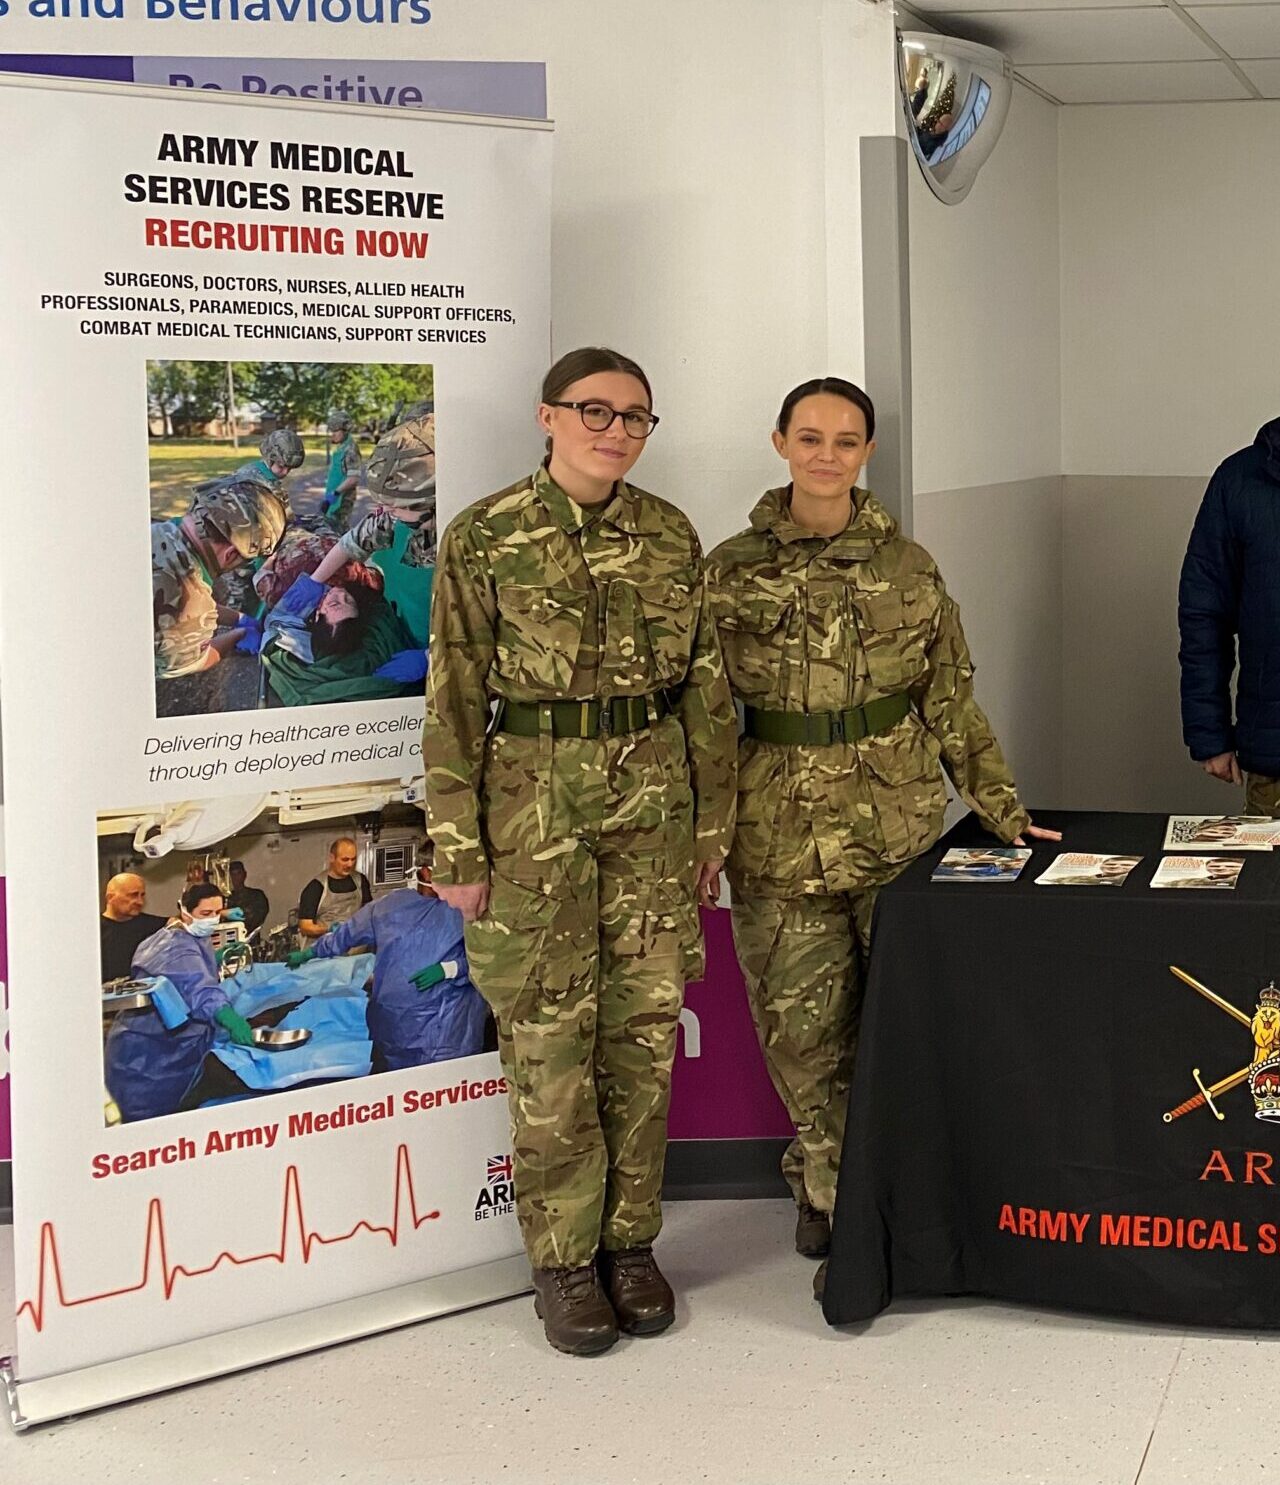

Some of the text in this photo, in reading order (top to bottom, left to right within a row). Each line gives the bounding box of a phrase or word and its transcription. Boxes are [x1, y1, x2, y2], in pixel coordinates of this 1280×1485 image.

[28, 0, 124, 18] and
[147, 0, 431, 24] Behaviours
[158, 133, 414, 178] ARMY MEDICAL
[124, 173, 444, 220] SERVICES RESERVE
[145, 218, 429, 259] RECRUITING NOW
[104, 271, 465, 299] SURGEONS, DOCTORS, NURSES, ALLIED HEALTH
[41, 295, 516, 325] PROFESSIONALS, PARAMEDICS, MEDICAL SUPPORT OFFICERS,
[80, 320, 487, 344] COMBAT MEDICAL TECHNICIANS, SUPPORT SERVICES
[144, 731, 243, 756] Delivering
[249, 721, 350, 746] healthcare
[149, 757, 228, 783] through
[234, 749, 325, 776] deployed
[331, 741, 404, 766] medical
[91, 1076, 508, 1180] Search Army Medical Services
[475, 1202, 514, 1221] BE THE
[998, 1203, 1091, 1244] ARMY
[1100, 1214, 1248, 1253] MEDICAL
